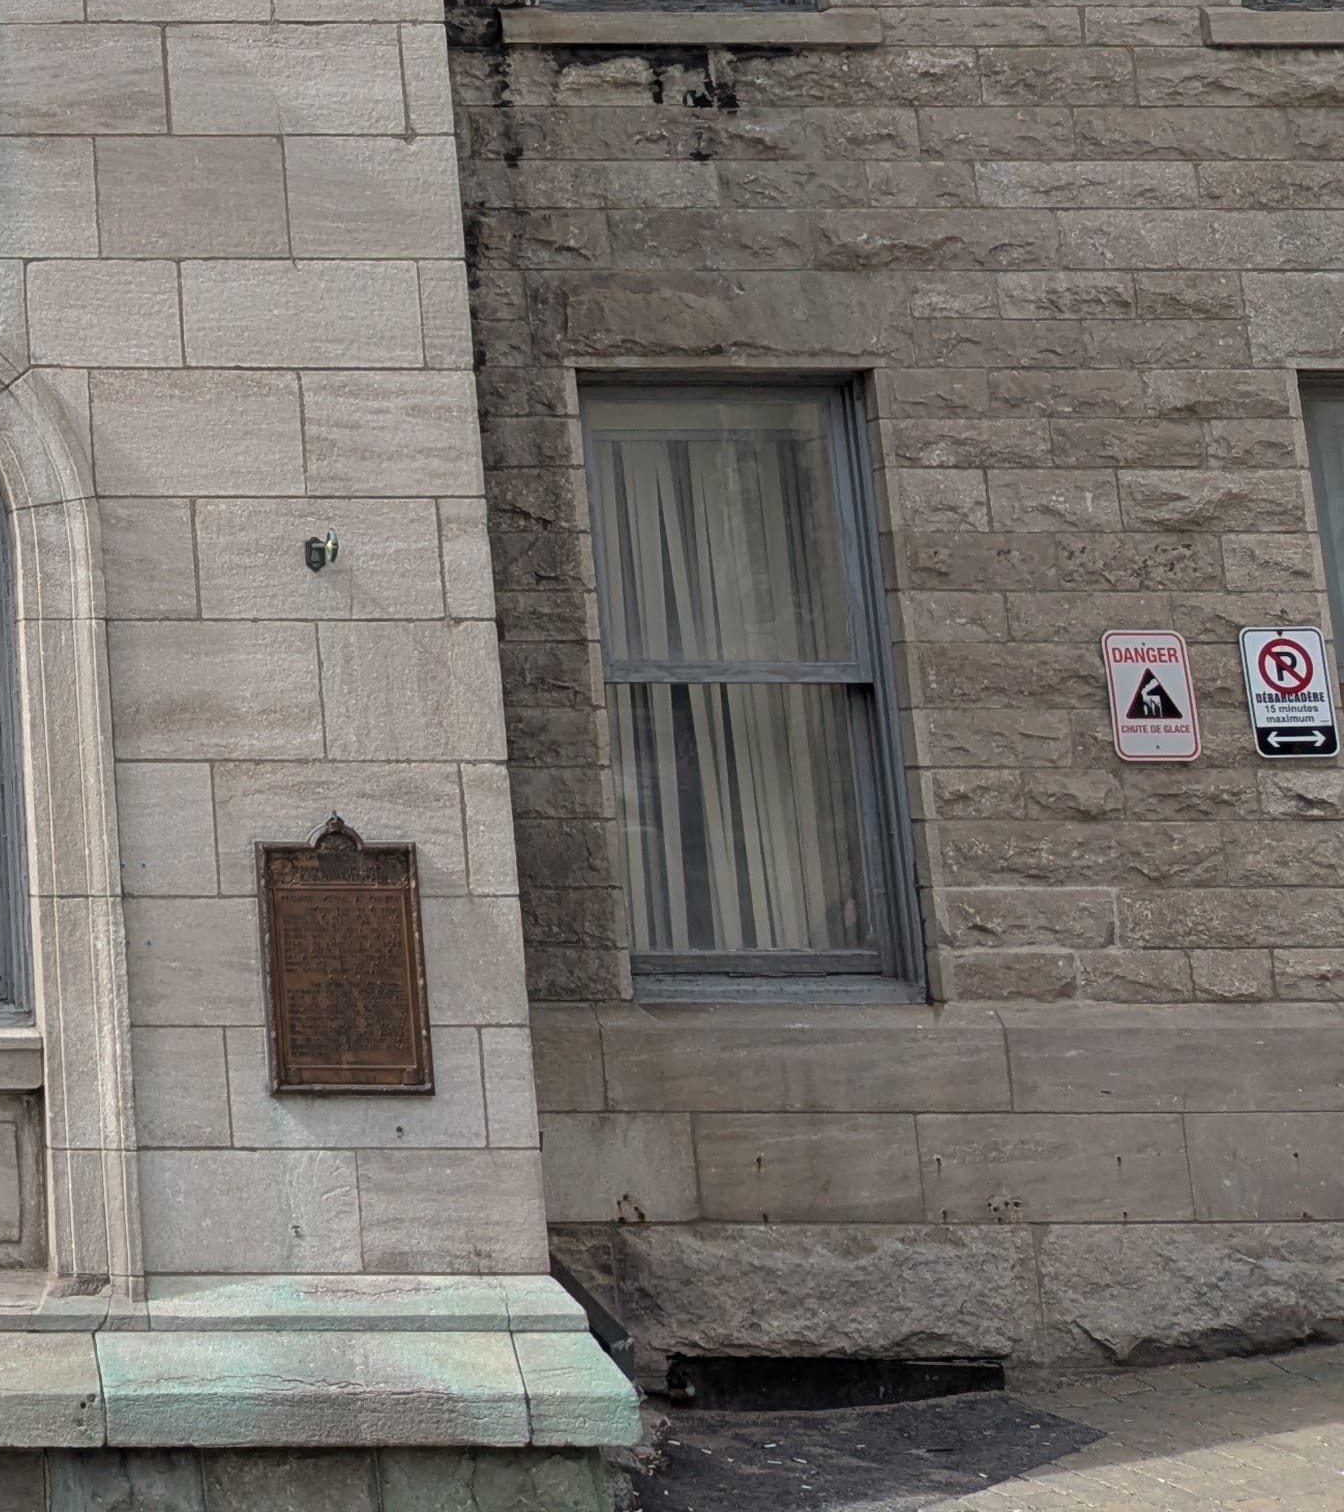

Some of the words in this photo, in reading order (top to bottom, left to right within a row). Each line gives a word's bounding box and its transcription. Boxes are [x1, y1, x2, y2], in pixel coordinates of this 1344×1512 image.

[1111, 647, 1179, 663] DANGER
[1255, 691, 1326, 704] DÉBARCADÈRE
[1265, 704, 1277, 713] 15
[1278, 704, 1319, 713] minutes
[1266, 714, 1315, 723] maximum
[1120, 724, 1149, 734] CHUTE
[1150, 724, 1162, 734] DE
[1163, 724, 1191, 734] GLACE
